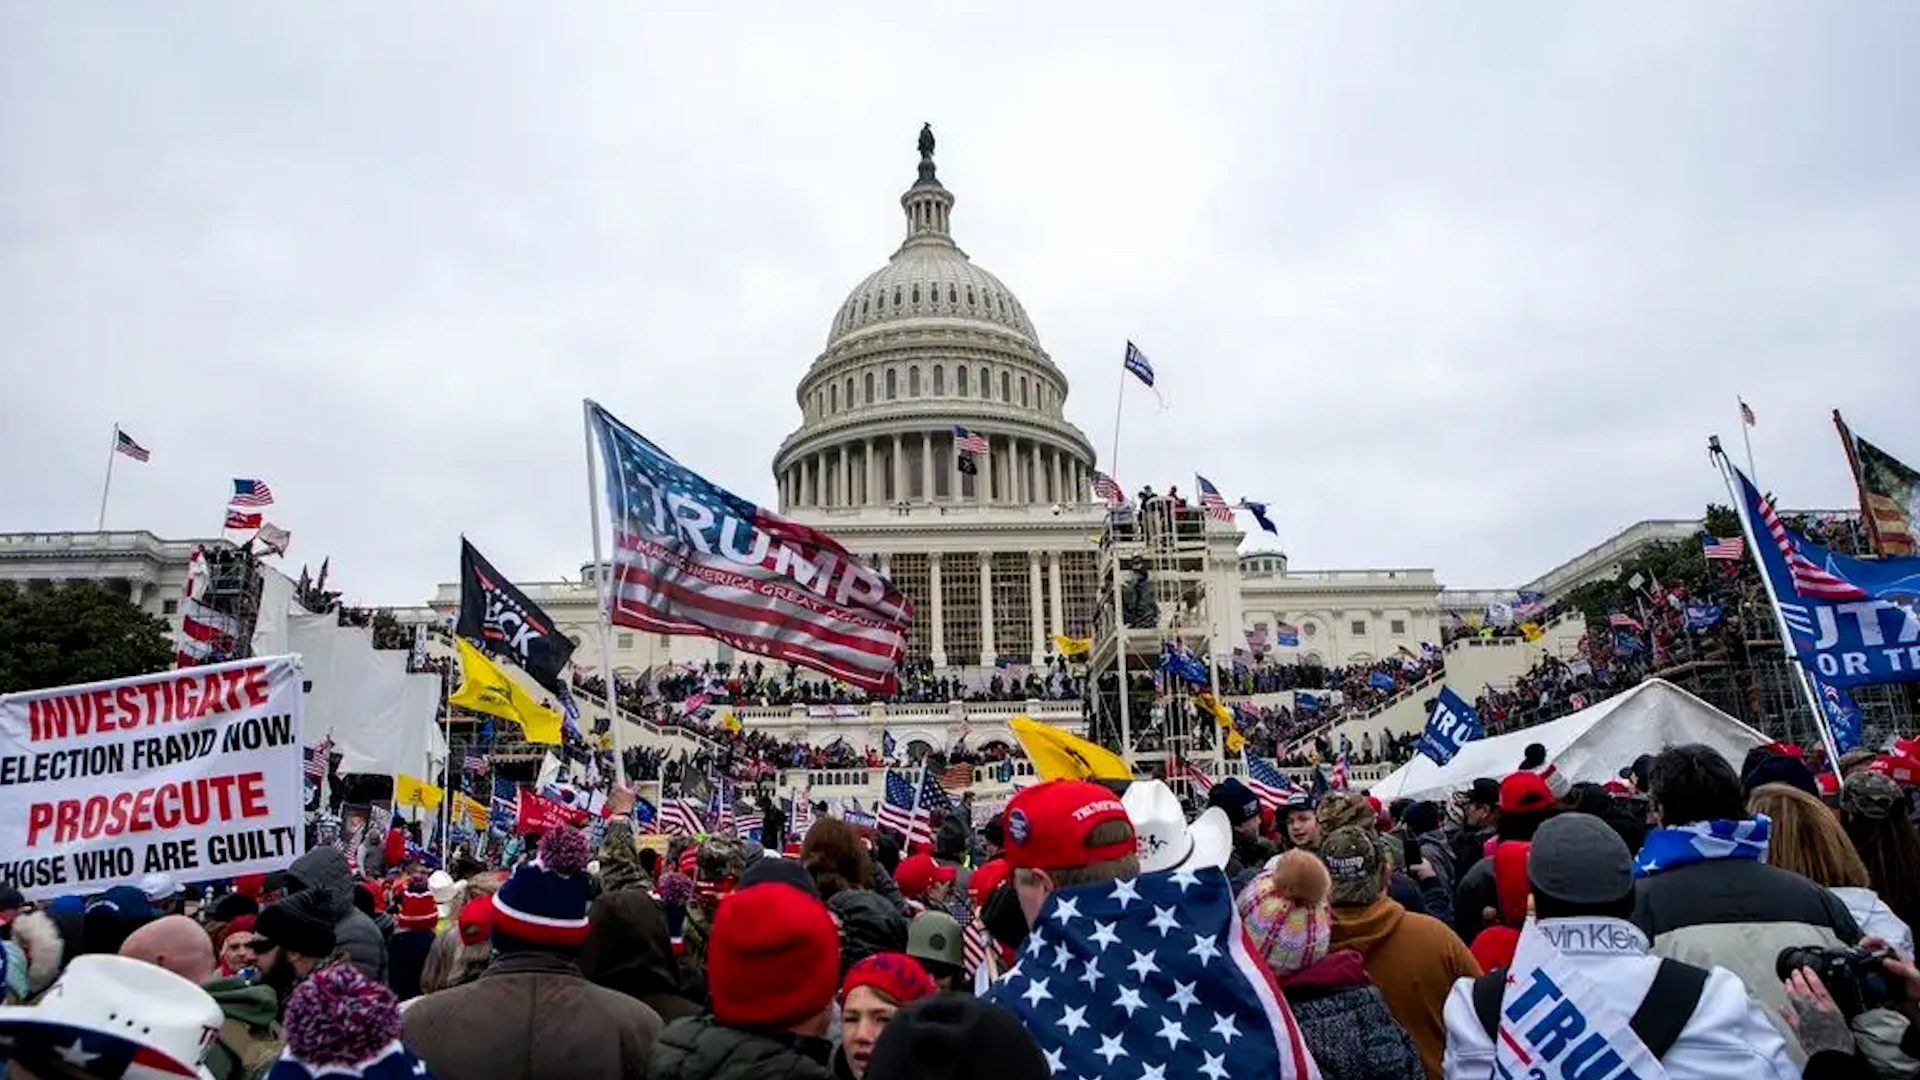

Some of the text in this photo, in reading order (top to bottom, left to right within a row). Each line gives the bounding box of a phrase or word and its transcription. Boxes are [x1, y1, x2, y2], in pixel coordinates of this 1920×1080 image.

[636, 472, 886, 606] TRUMP
[760, 582, 820, 611] GREAT
[27, 665, 269, 742] INVESTIGATE
[0, 714, 296, 785] ELECTION FRAUD NOW.
[27, 771, 269, 847] PROSECUTE
[73, 846, 134, 881] WHO
[143, 839, 199, 874] ARE
[207, 825, 296, 865] GUILTY
[1541, 924, 1584, 949] vin
